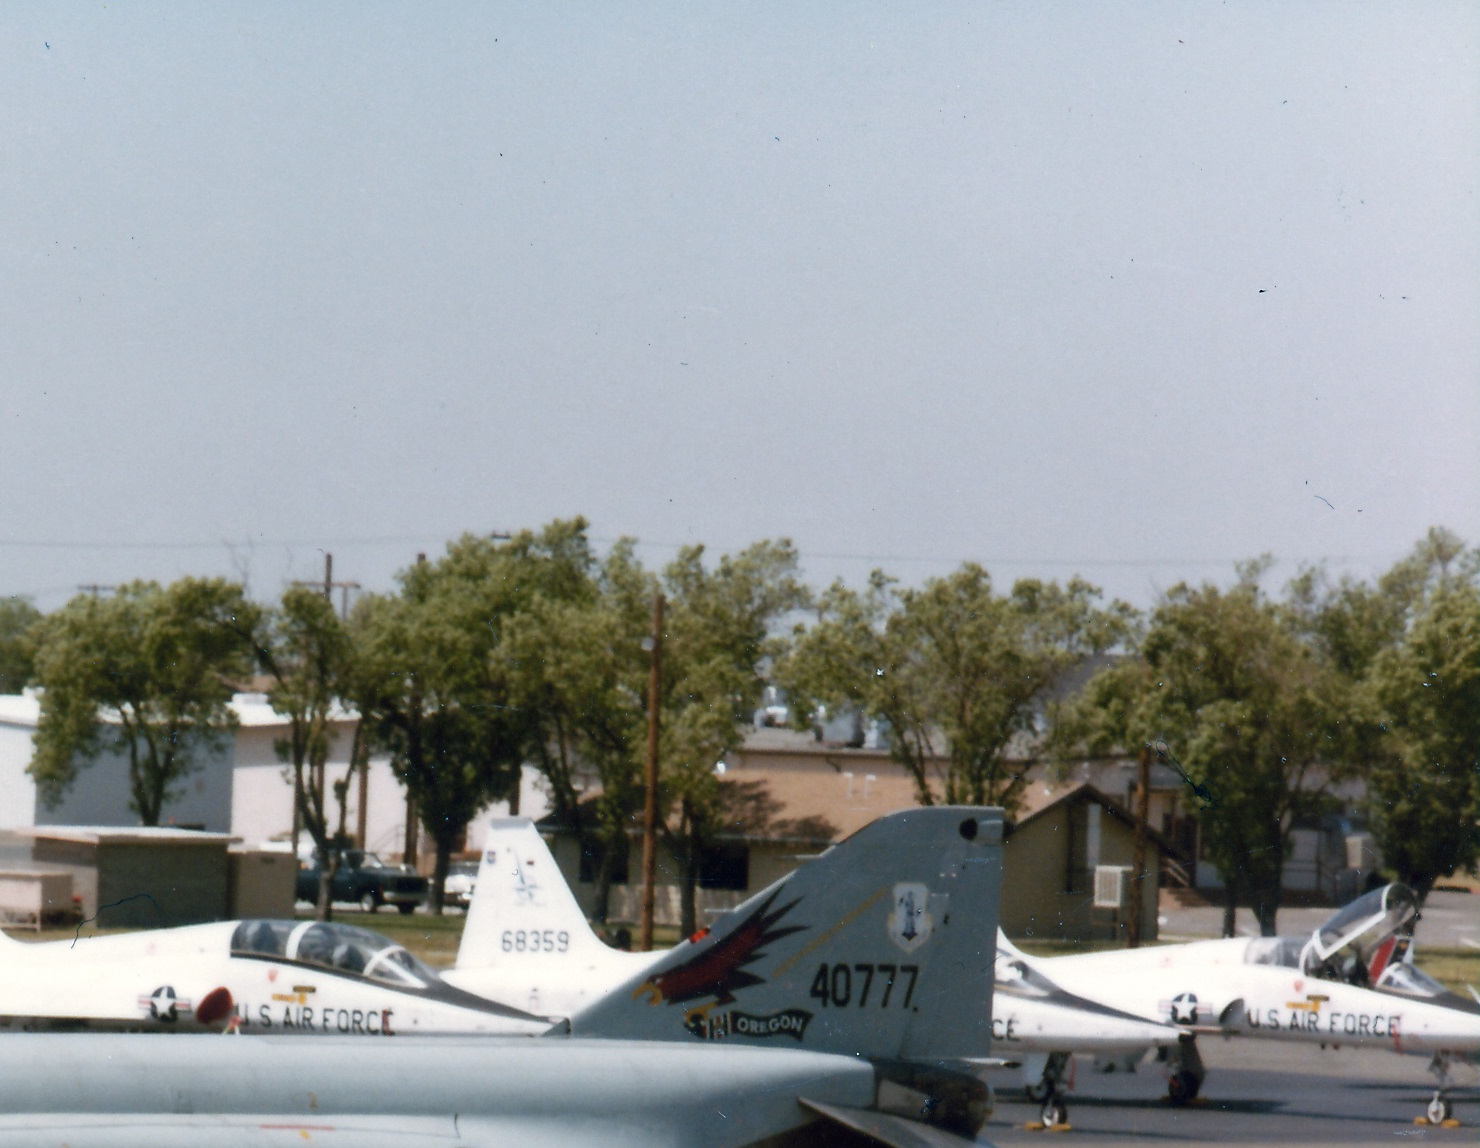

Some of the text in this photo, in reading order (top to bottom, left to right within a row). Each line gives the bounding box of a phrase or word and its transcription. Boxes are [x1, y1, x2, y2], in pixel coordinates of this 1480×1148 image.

[502, 930, 569, 952] 68359
[809, 963, 920, 1008] 40777
[283, 1006, 316, 1031] AIR
[322, 1008, 396, 1036] FORCE
[736, 1014, 803, 1034] OREGON
[1289, 1010, 1321, 1033] AIR
[1330, 1012, 1402, 1038] FORCE
